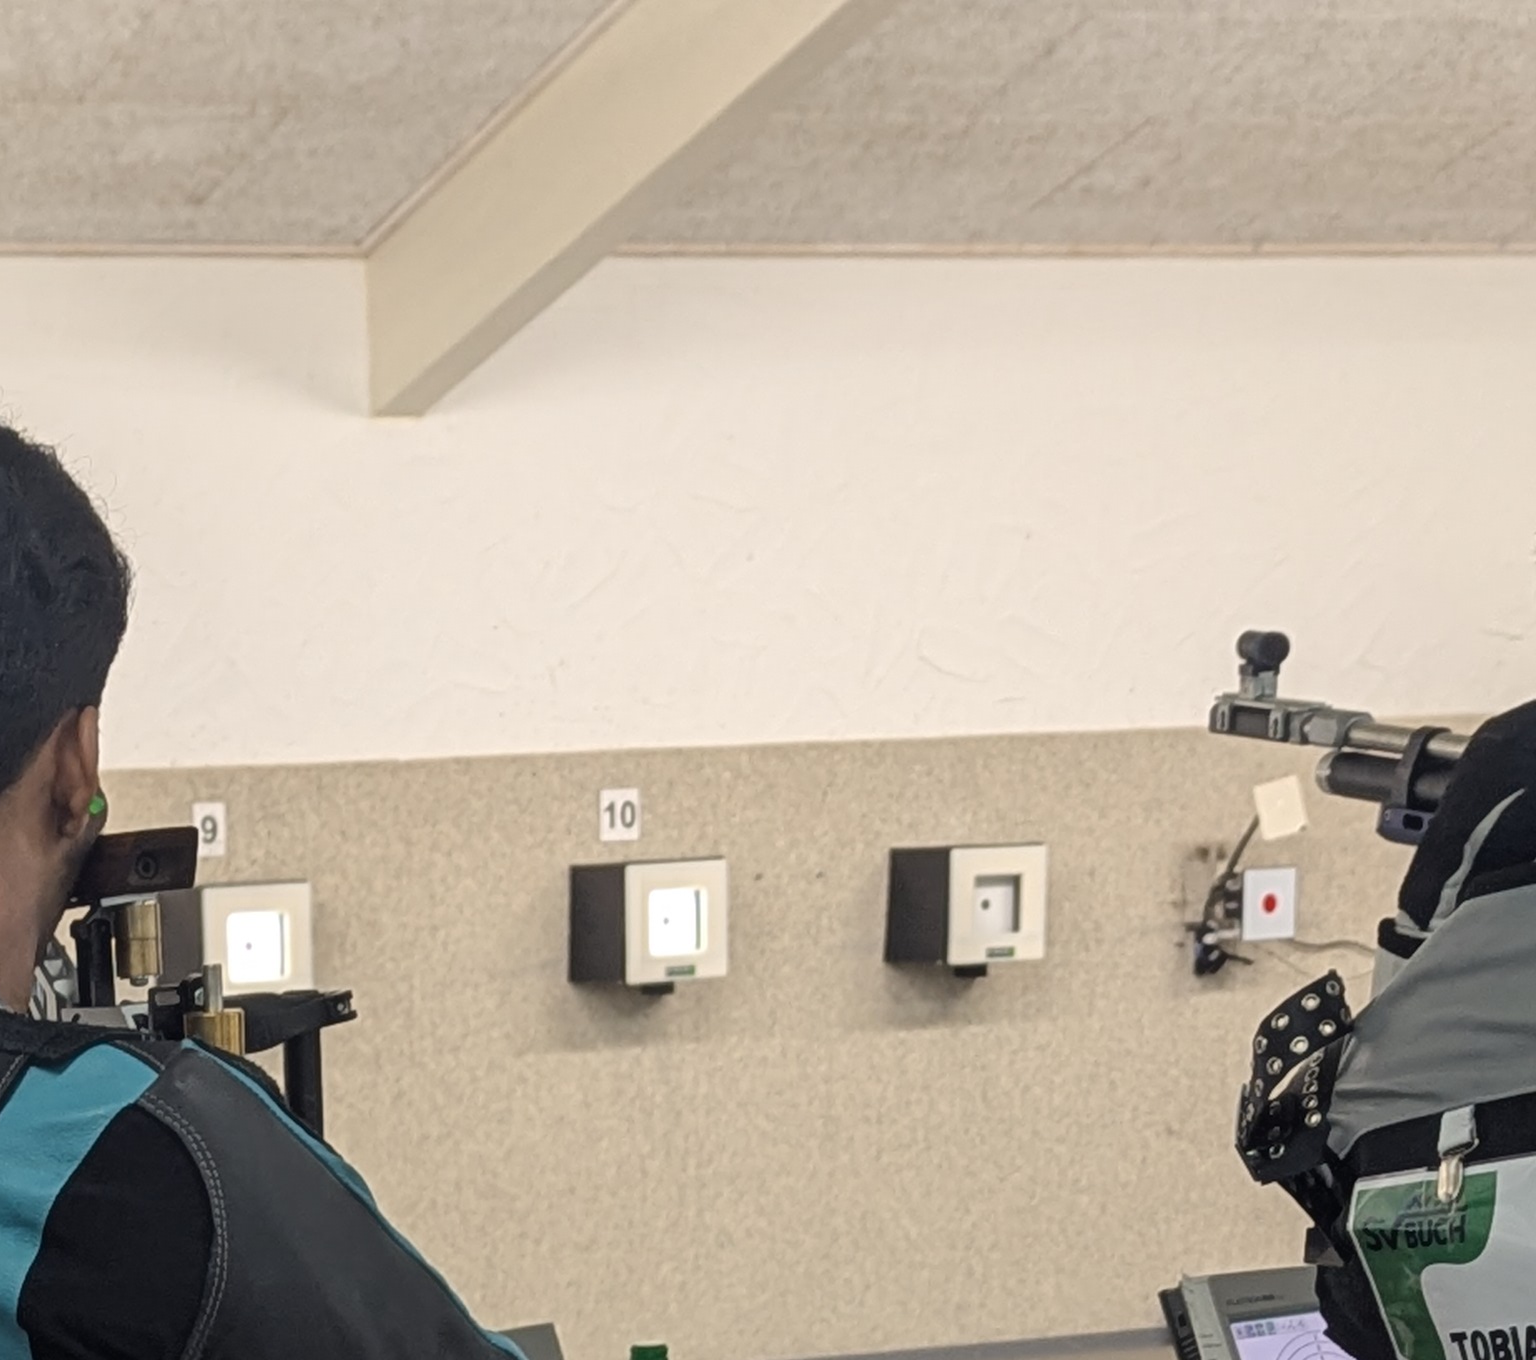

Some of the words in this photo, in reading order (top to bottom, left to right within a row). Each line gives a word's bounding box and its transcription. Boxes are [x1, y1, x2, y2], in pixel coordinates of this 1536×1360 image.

[604, 800, 636, 829] 10
[201, 815, 217, 844] 9
[1364, 1219, 1400, 1250] SV
[1405, 1216, 1466, 1249] BUCH
